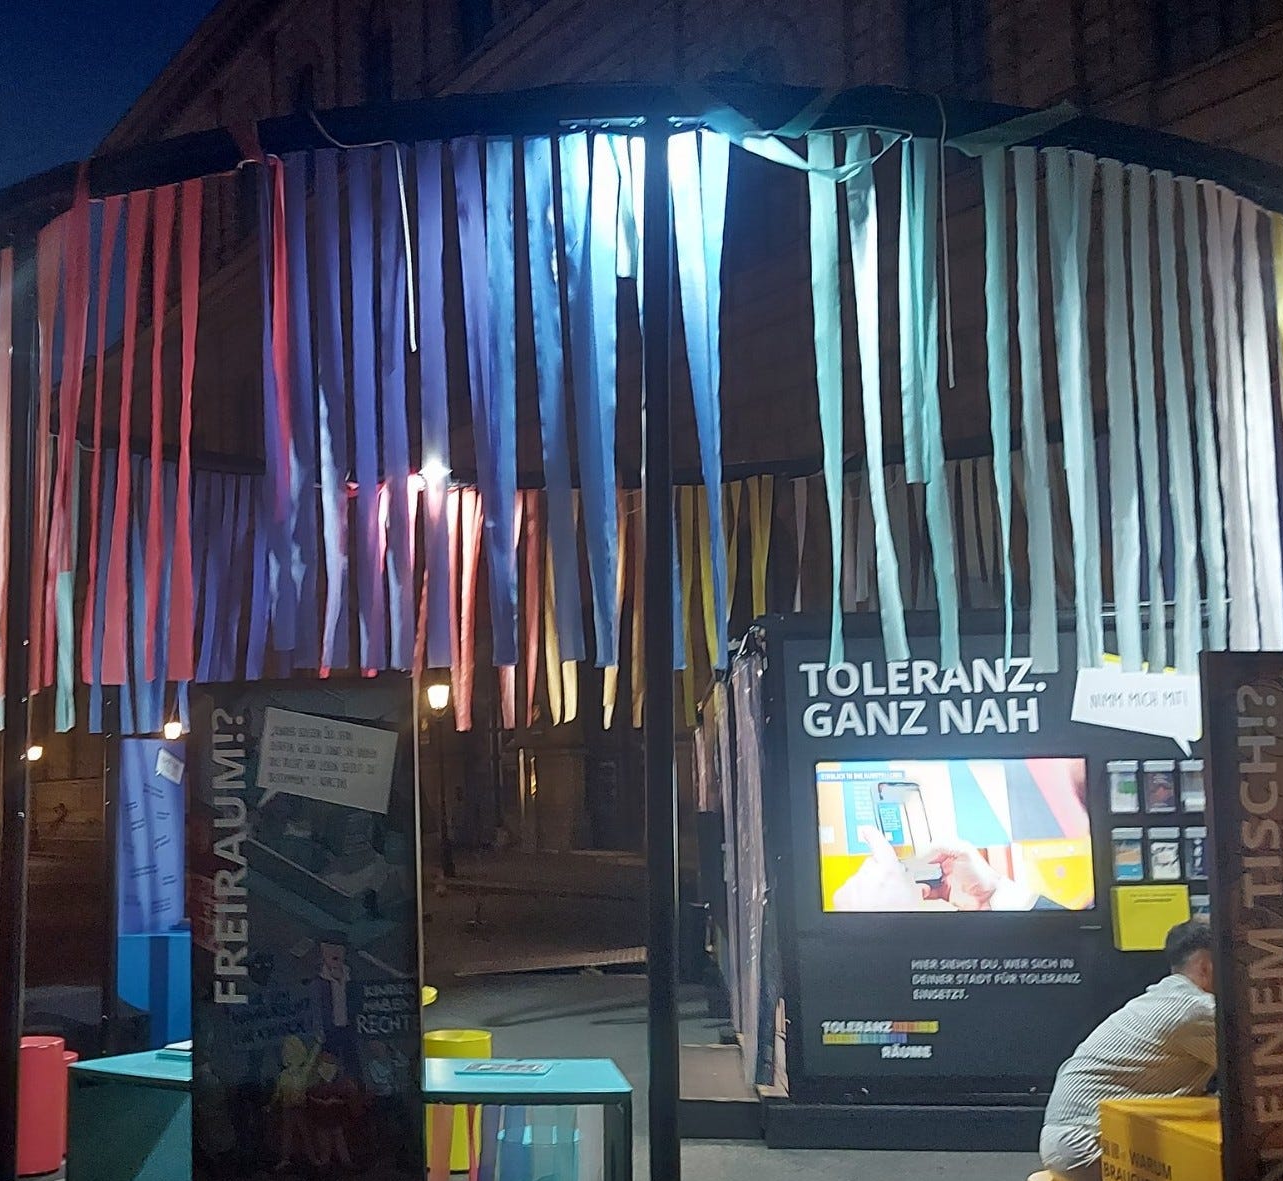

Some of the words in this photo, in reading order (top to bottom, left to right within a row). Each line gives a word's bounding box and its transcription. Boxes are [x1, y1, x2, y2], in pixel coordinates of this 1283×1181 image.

[799, 656, 1047, 697] TOLERANZ.
[803, 700, 928, 737] GANZ
[939, 697, 1039, 734] NAH
[211, 708, 249, 1004] FREIRAUM!?
[911, 959, 938, 970] HIER
[980, 959, 1002, 971] DU,
[1003, 959, 1029, 970] WER
[1031, 959, 1059, 970] SICH
[1060, 959, 1075, 969] IN
[912, 974, 954, 985] DEINER
[957, 974, 993, 985] STADT
[995, 973, 1019, 985] FÜR
[1020, 973, 1082, 984] TOLERANZ
[821, 1021, 893, 1033] TOLERANZ
